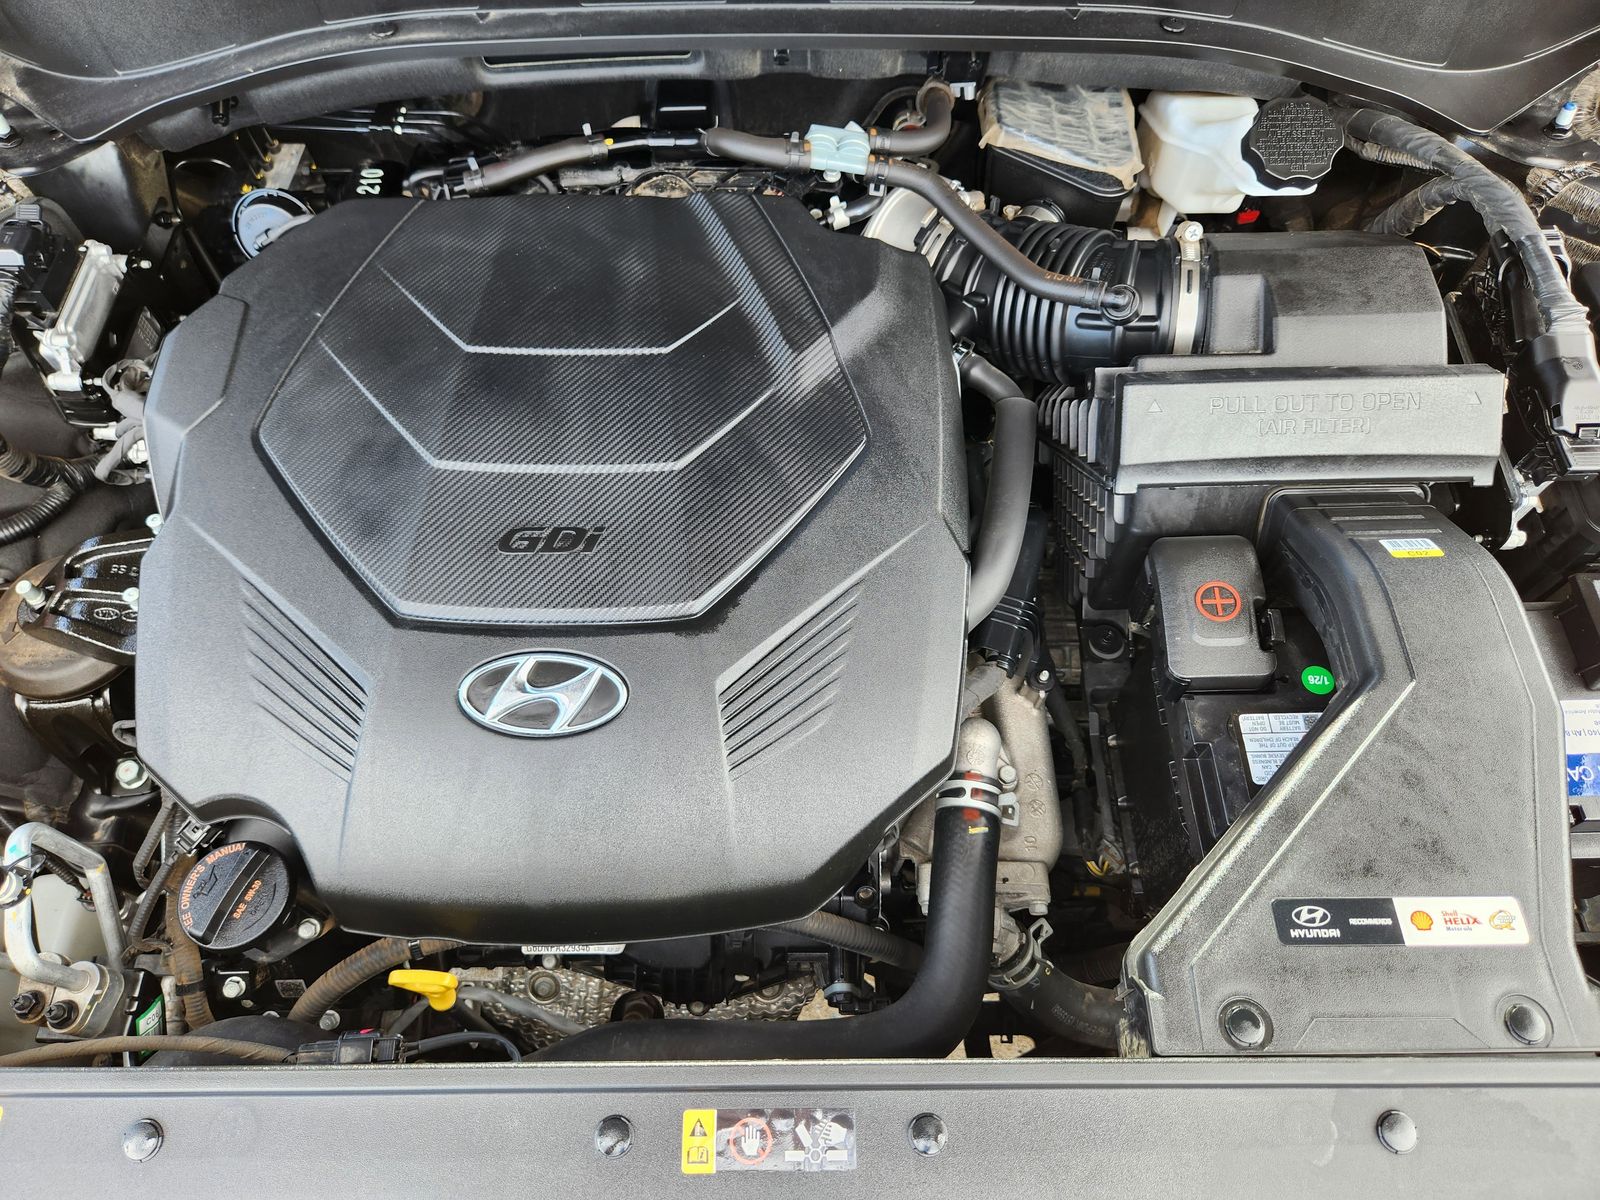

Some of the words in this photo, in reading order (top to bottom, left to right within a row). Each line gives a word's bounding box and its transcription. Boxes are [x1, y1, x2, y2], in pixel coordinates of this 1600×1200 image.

[356, 168, 384, 195] 210
[1209, 396, 1266, 414] PULL
[1273, 394, 1320, 413] OUT
[1325, 393, 1354, 412] TO
[1361, 392, 1422, 411] OPEN
[1258, 418, 1297, 436] (AIR
[1302, 417, 1372, 434] FILTER)
[498, 526, 607, 554] GDi
[1567, 765, 1595, 781] CA
[181, 864, 206, 910] OWNER'S
[232, 902, 248, 920] SAE
[1443, 917, 1482, 925] HELIX
[1289, 928, 1341, 938] HYUNDAI
